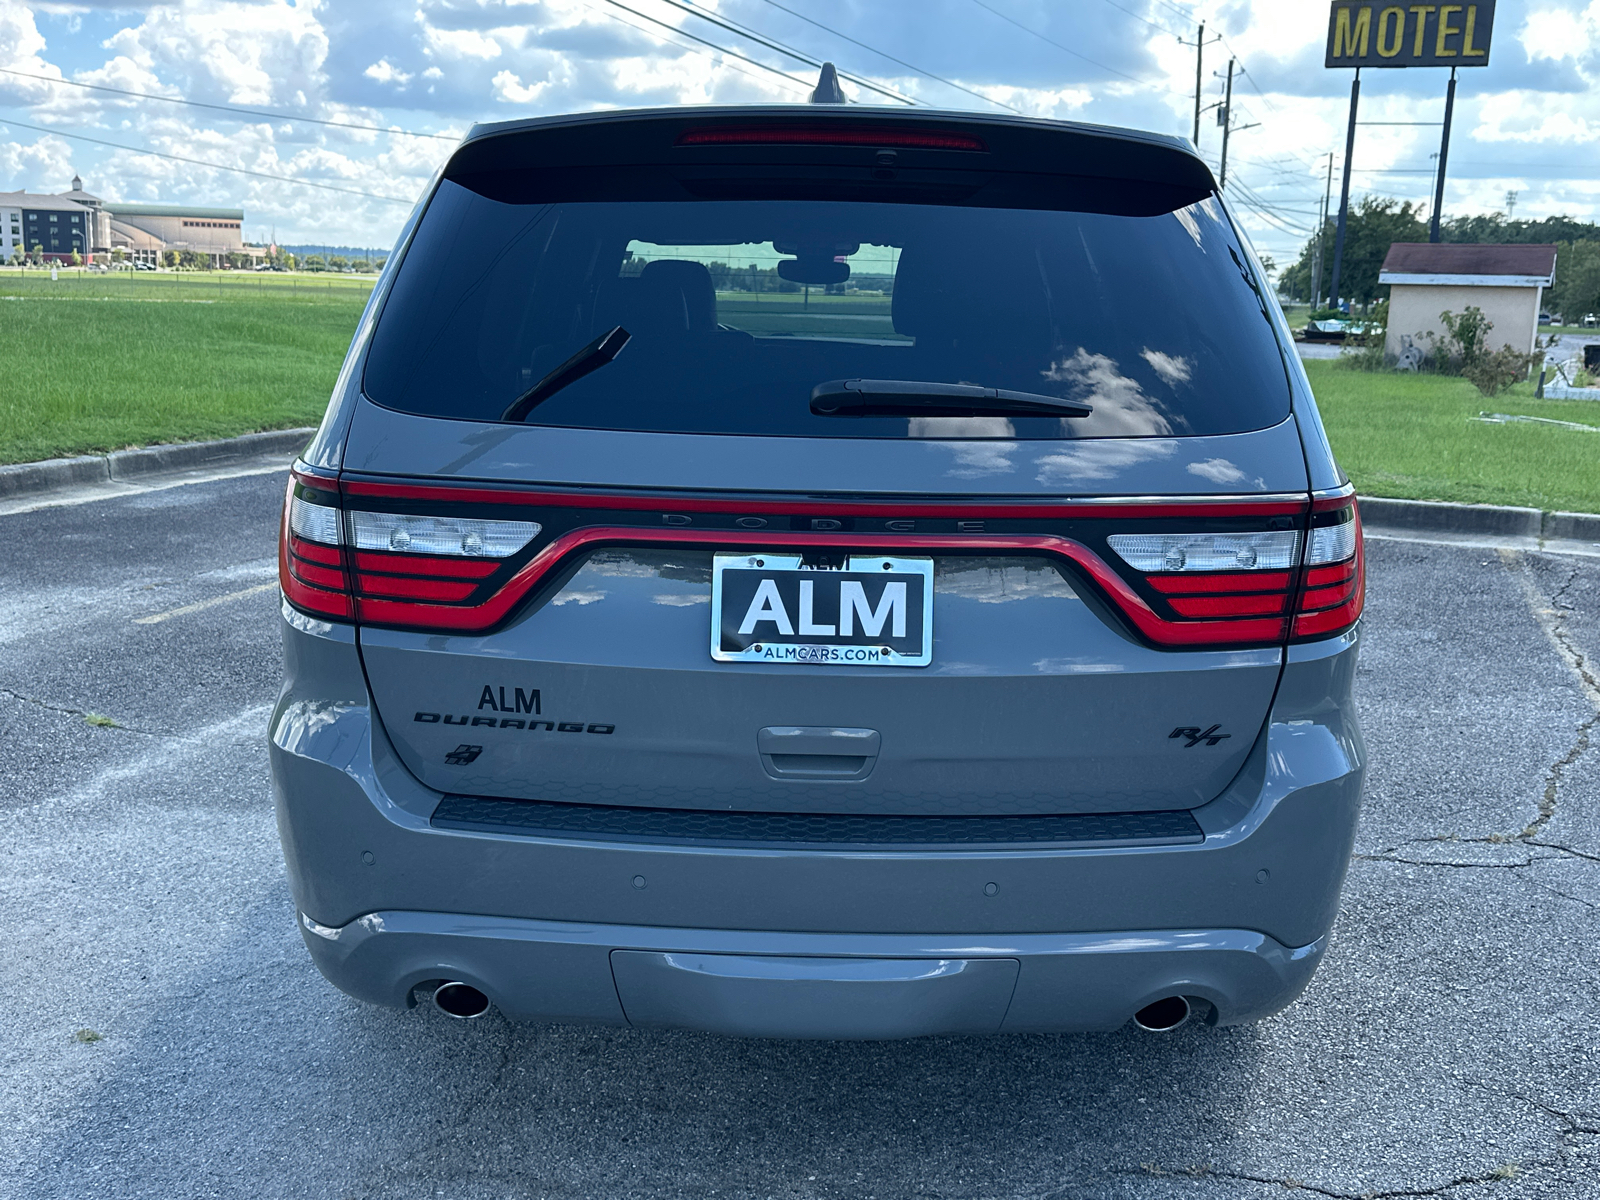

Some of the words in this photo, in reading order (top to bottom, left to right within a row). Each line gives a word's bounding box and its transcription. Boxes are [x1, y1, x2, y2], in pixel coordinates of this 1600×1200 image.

[1333, 5, 1485, 58] MOTEL
[662, 513, 986, 533] DODGE
[738, 579, 907, 638] ALM
[763, 646, 880, 661] ALMCARS.COM
[477, 684, 541, 715] ALM
[413, 711, 616, 735] DURANGO
[1168, 723, 1232, 748] R/T
